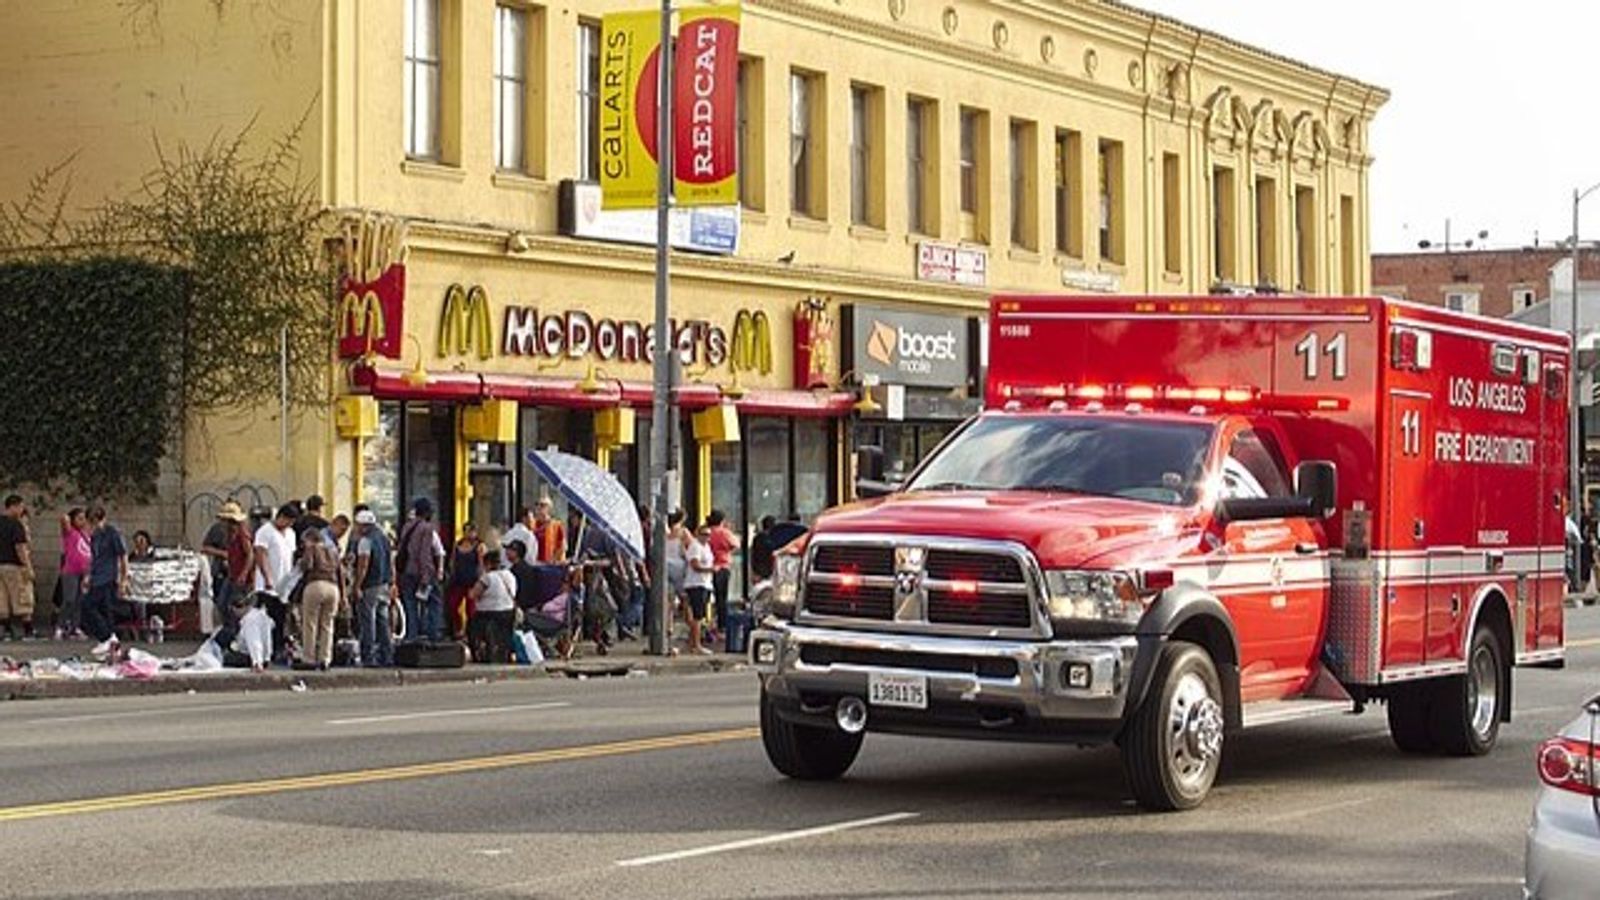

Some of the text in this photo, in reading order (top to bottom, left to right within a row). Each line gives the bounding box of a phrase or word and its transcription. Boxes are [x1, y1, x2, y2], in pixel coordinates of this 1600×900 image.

[693, 25, 718, 176] REDCAT
[898, 326, 956, 360] boost
[1295, 331, 1347, 381] 11
[1449, 376, 1526, 414] LOS ANGELES
[1401, 409, 1420, 456] 11
[1435, 431, 1536, 465] FIRE DEPARTMENT
